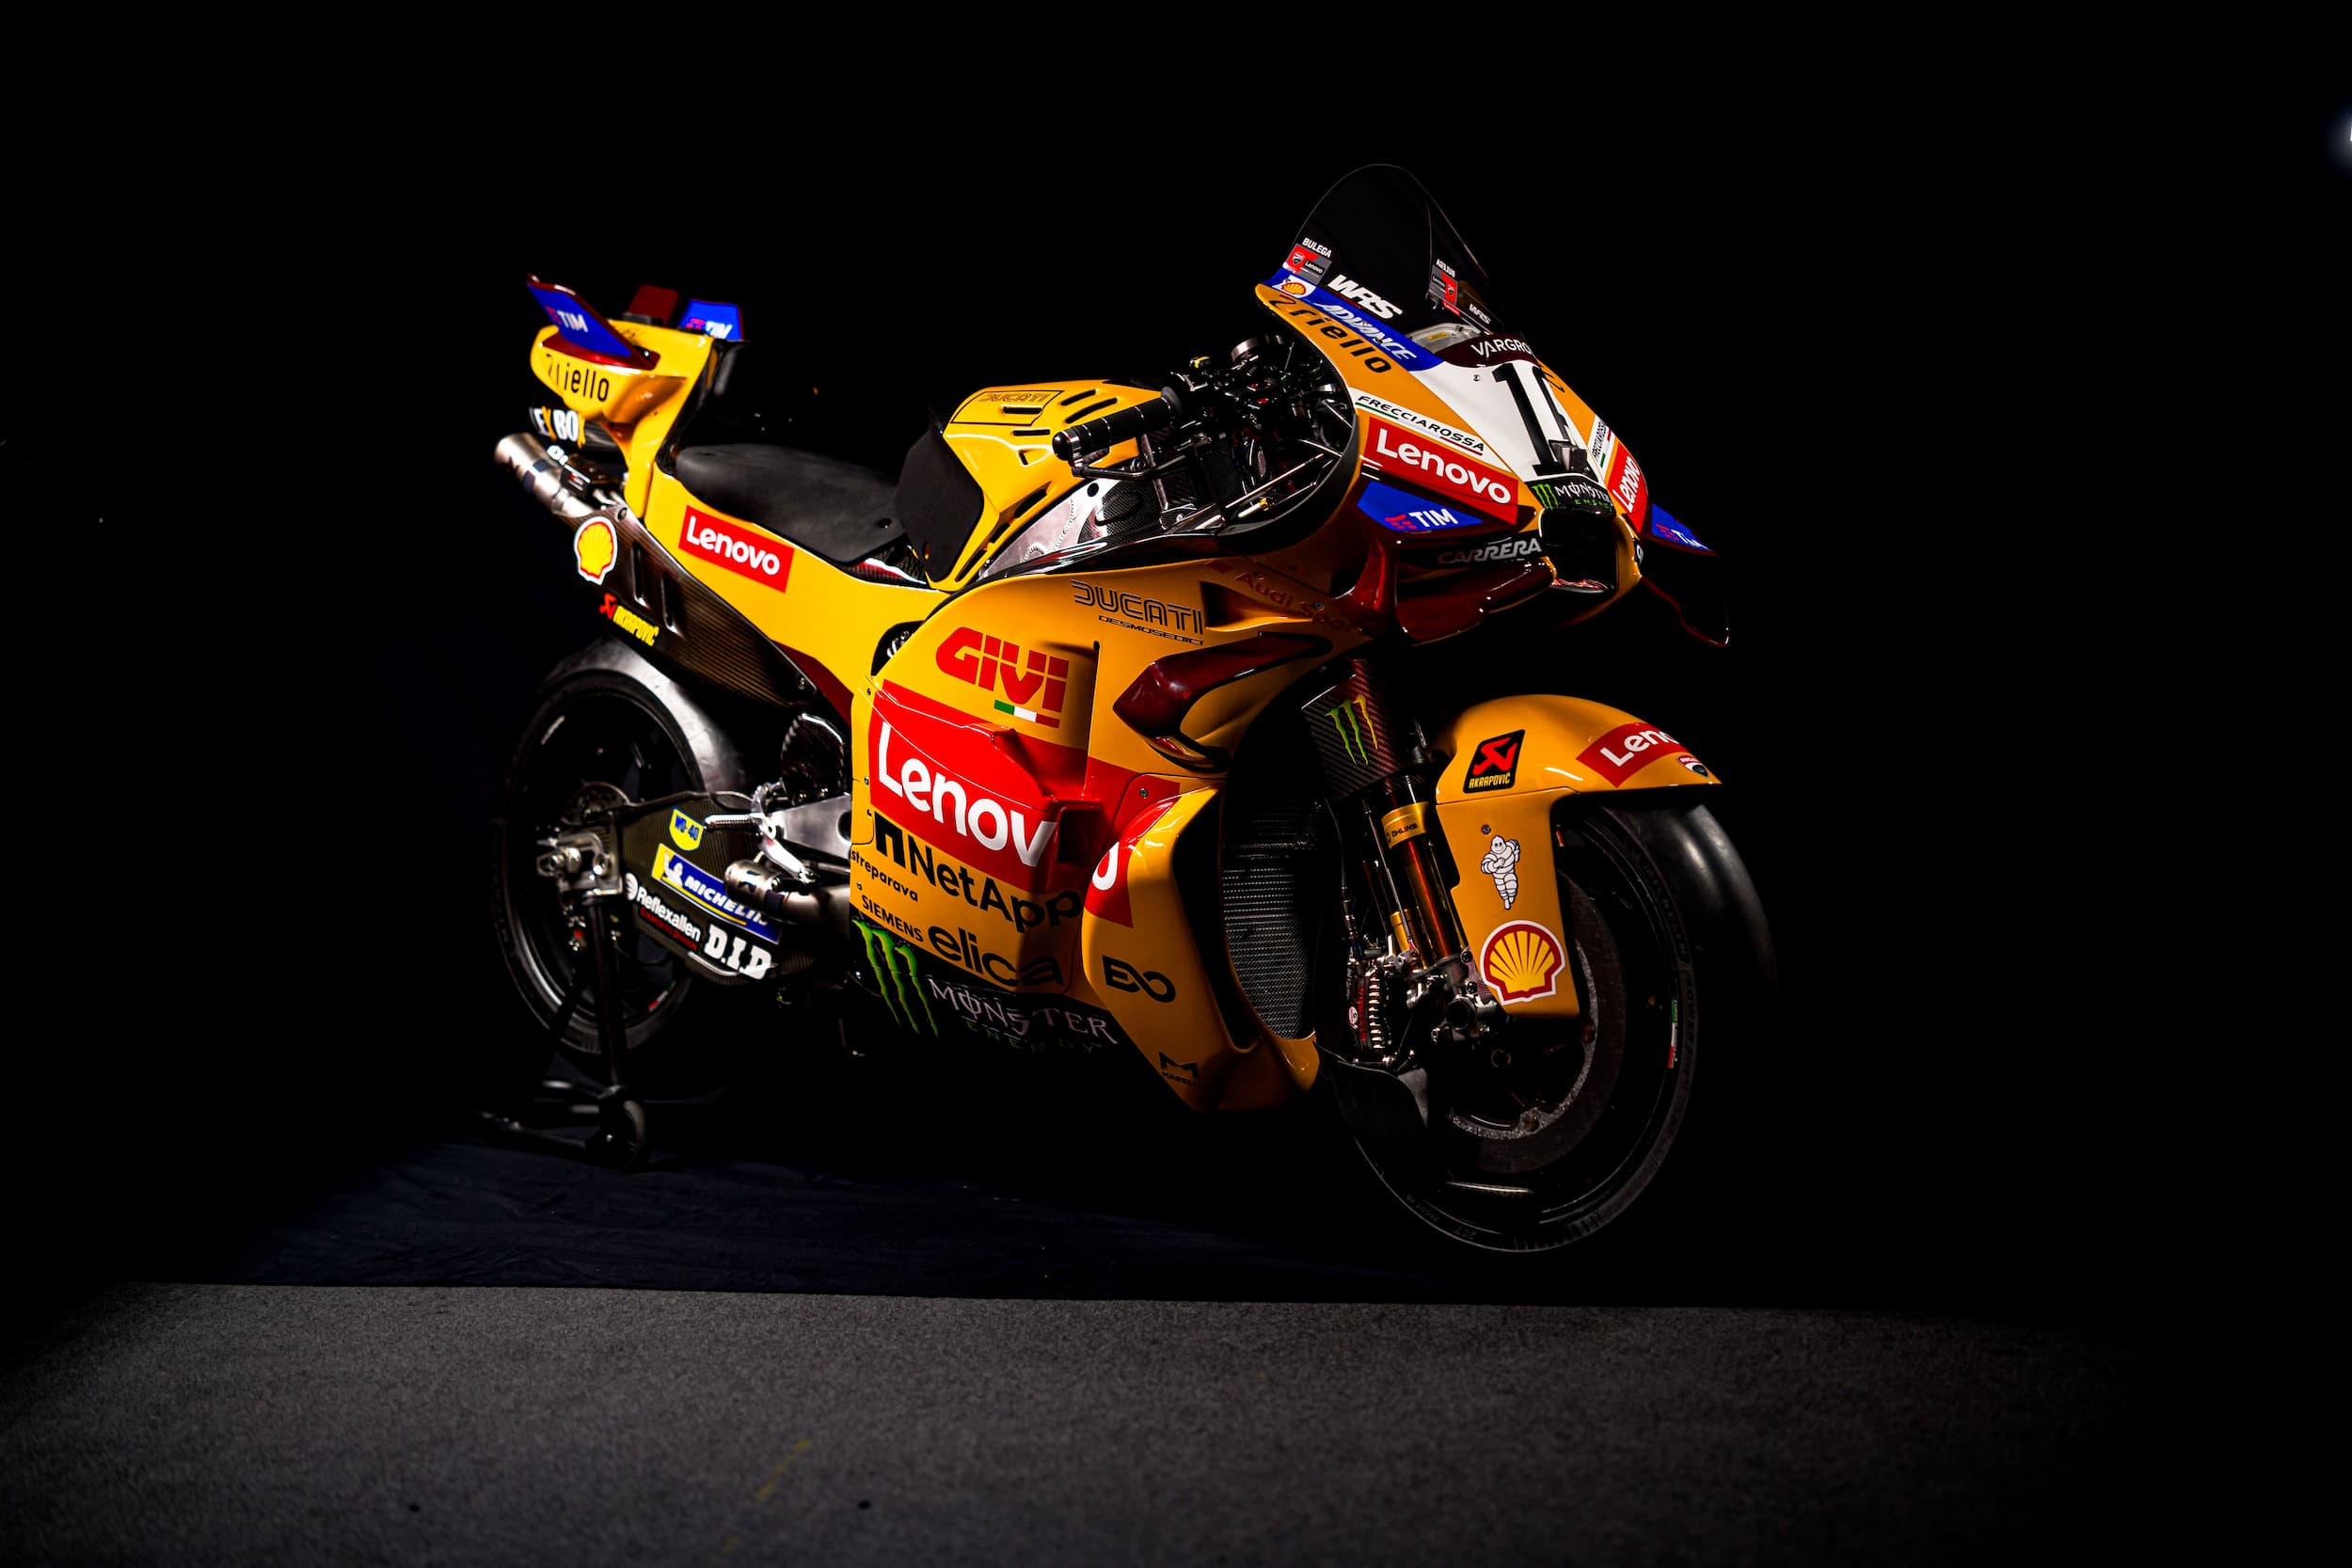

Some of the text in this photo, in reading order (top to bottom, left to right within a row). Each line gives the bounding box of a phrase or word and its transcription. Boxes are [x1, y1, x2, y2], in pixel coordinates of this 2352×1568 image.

[1302, 237, 1332, 259] BULEGA
[557, 309, 589, 333] TIM
[1327, 274, 1403, 319] WRS
[1358, 395, 1485, 452] FRECCIAROSSA
[1375, 428, 1512, 504] Lenovo
[1408, 508, 1460, 528] TIM
[685, 515, 782, 577] Lenovo
[1436, 536, 1542, 565] CARRERA
[1071, 578, 1203, 635] DUCATI
[1098, 614, 1204, 646] DESMOSEDICI
[935, 626, 1070, 713] GIVI
[675, 815, 700, 841] WD-40
[851, 849, 919, 903] streparava
[908, 834, 1081, 934] NetApp
[636, 885, 702, 942] Reflexallen
[861, 894, 925, 942] SIEMENS
[928, 926, 1065, 987] elica
[927, 978, 1120, 1046] MONSTER
